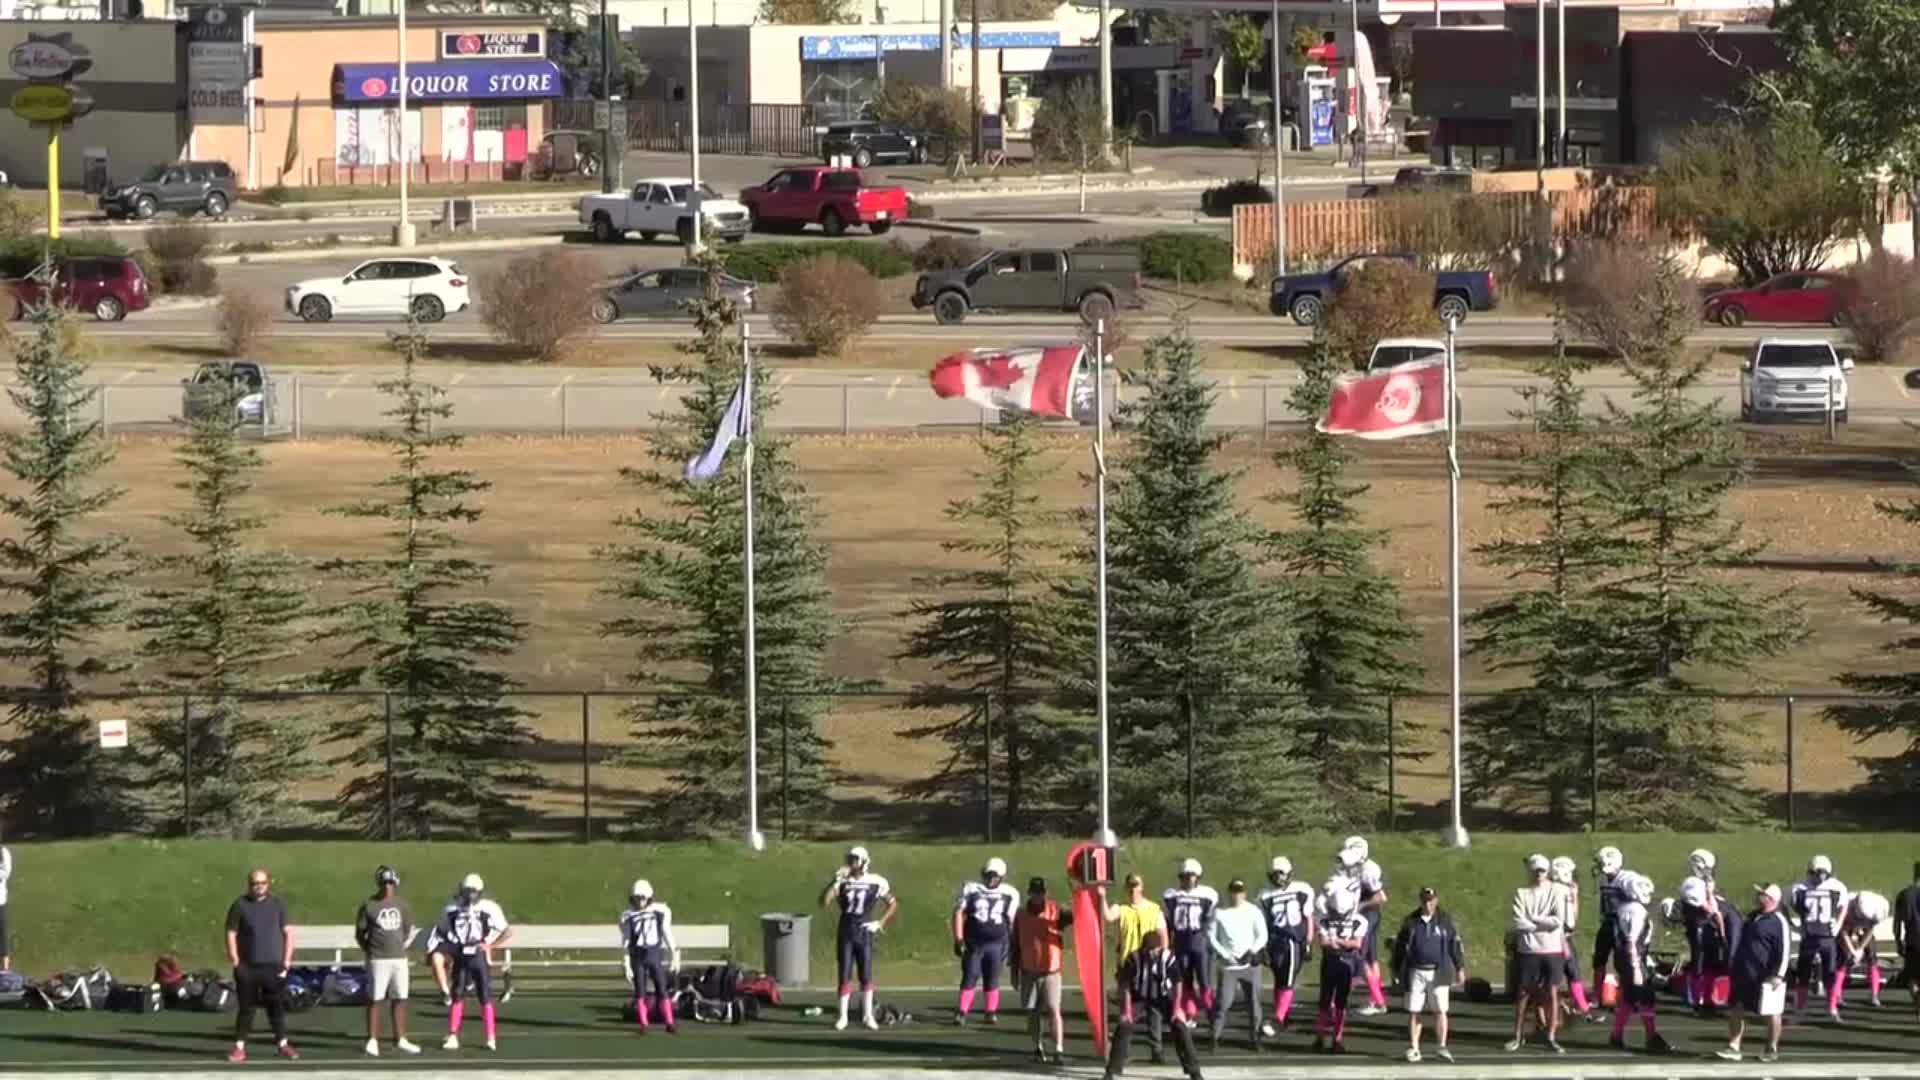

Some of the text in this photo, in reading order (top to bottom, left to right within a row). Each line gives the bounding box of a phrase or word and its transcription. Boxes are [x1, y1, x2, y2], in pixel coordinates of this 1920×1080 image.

[483, 34, 528, 44] LIQUOR
[486, 44, 525, 55] STORE
[488, 74, 552, 92] STORE
[1091, 847, 1107, 881] 1
[846, 889, 867, 915] 11
